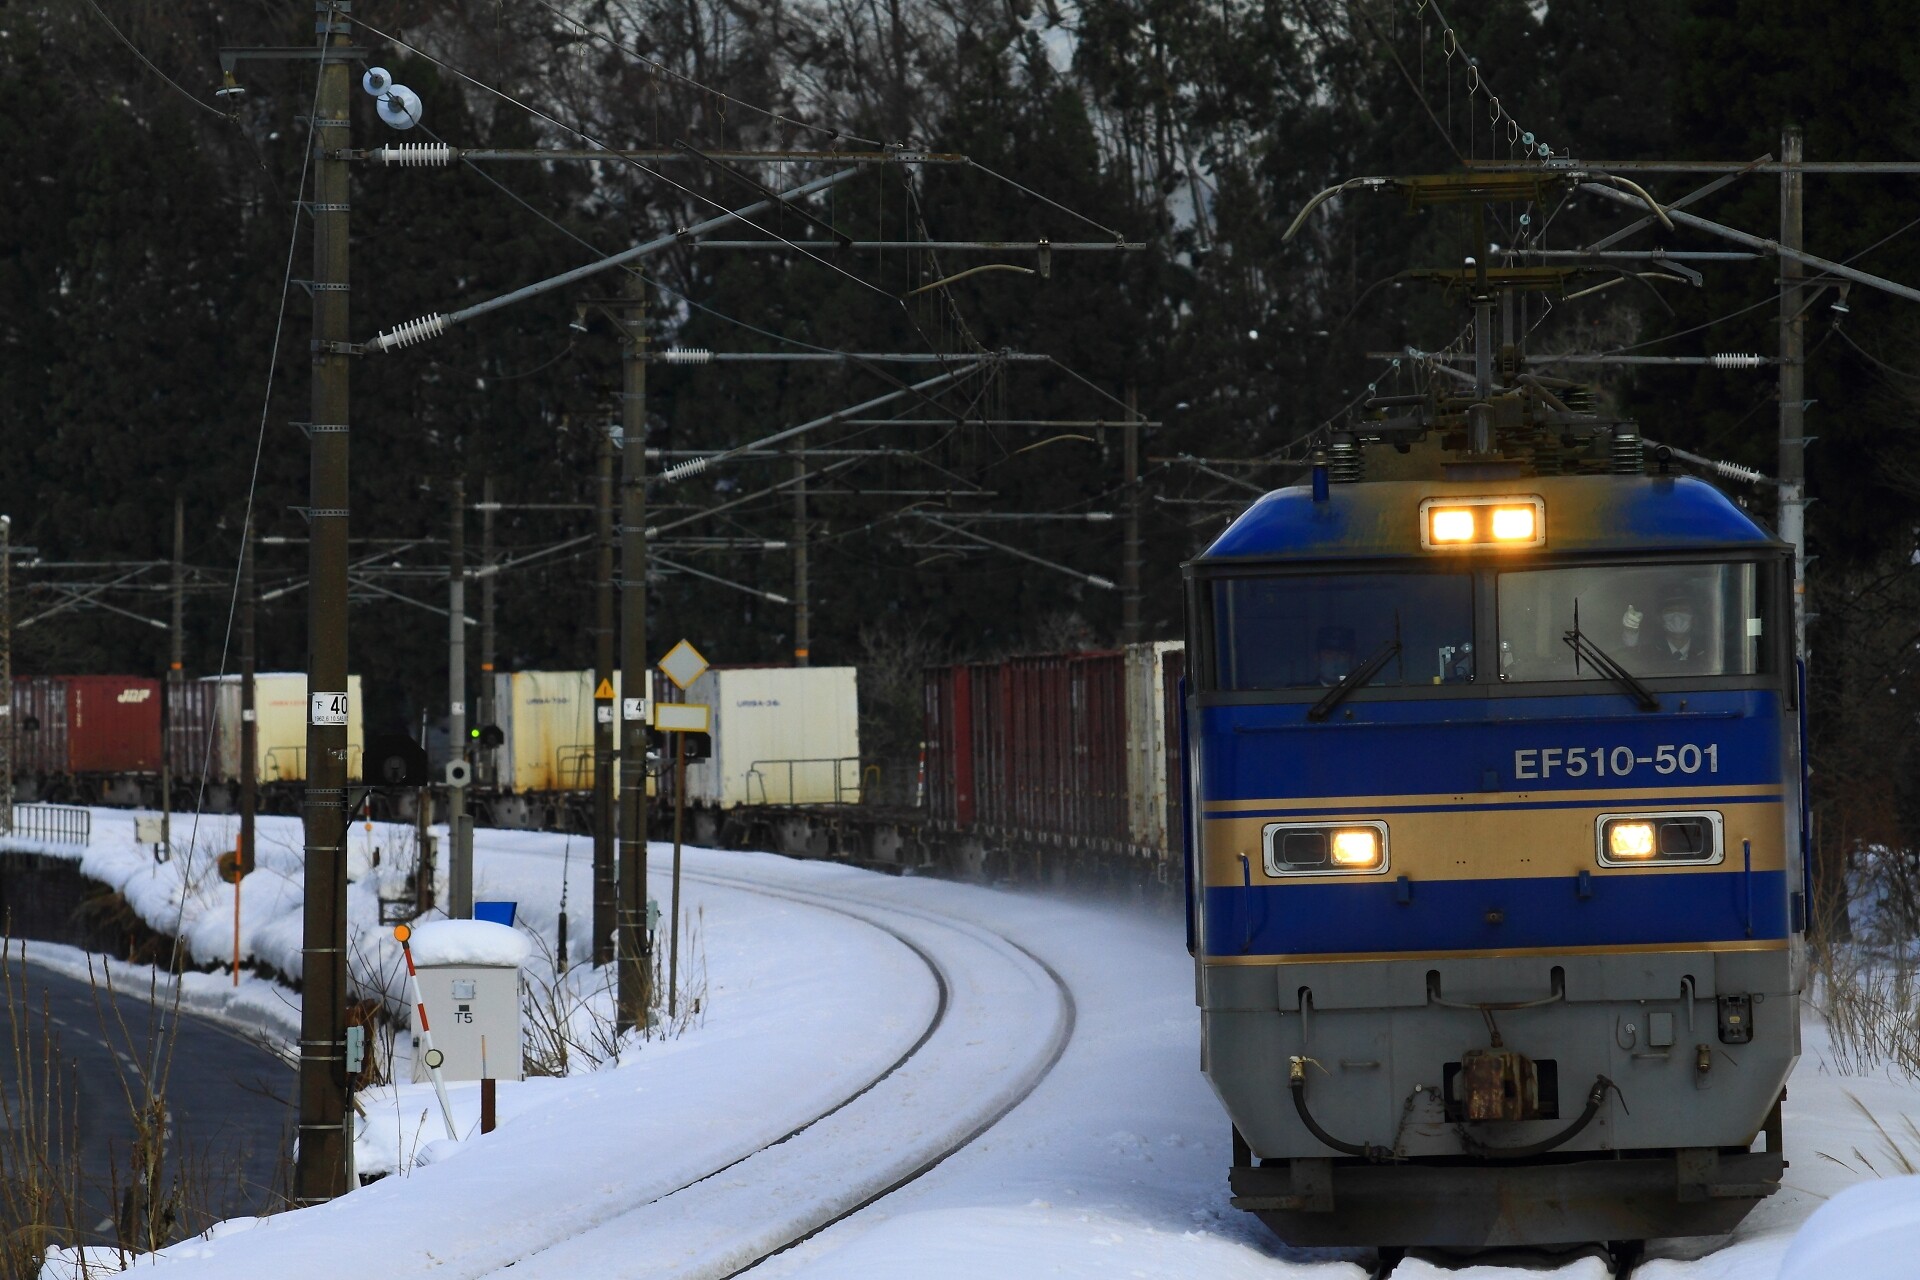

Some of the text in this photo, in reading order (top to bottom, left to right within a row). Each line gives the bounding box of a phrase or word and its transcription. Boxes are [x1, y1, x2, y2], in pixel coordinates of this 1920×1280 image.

[315, 701, 323, 709] 下
[331, 696, 347, 714] 40
[1515, 743, 1718, 779] EF510-501
[454, 1012, 473, 1024] T5
